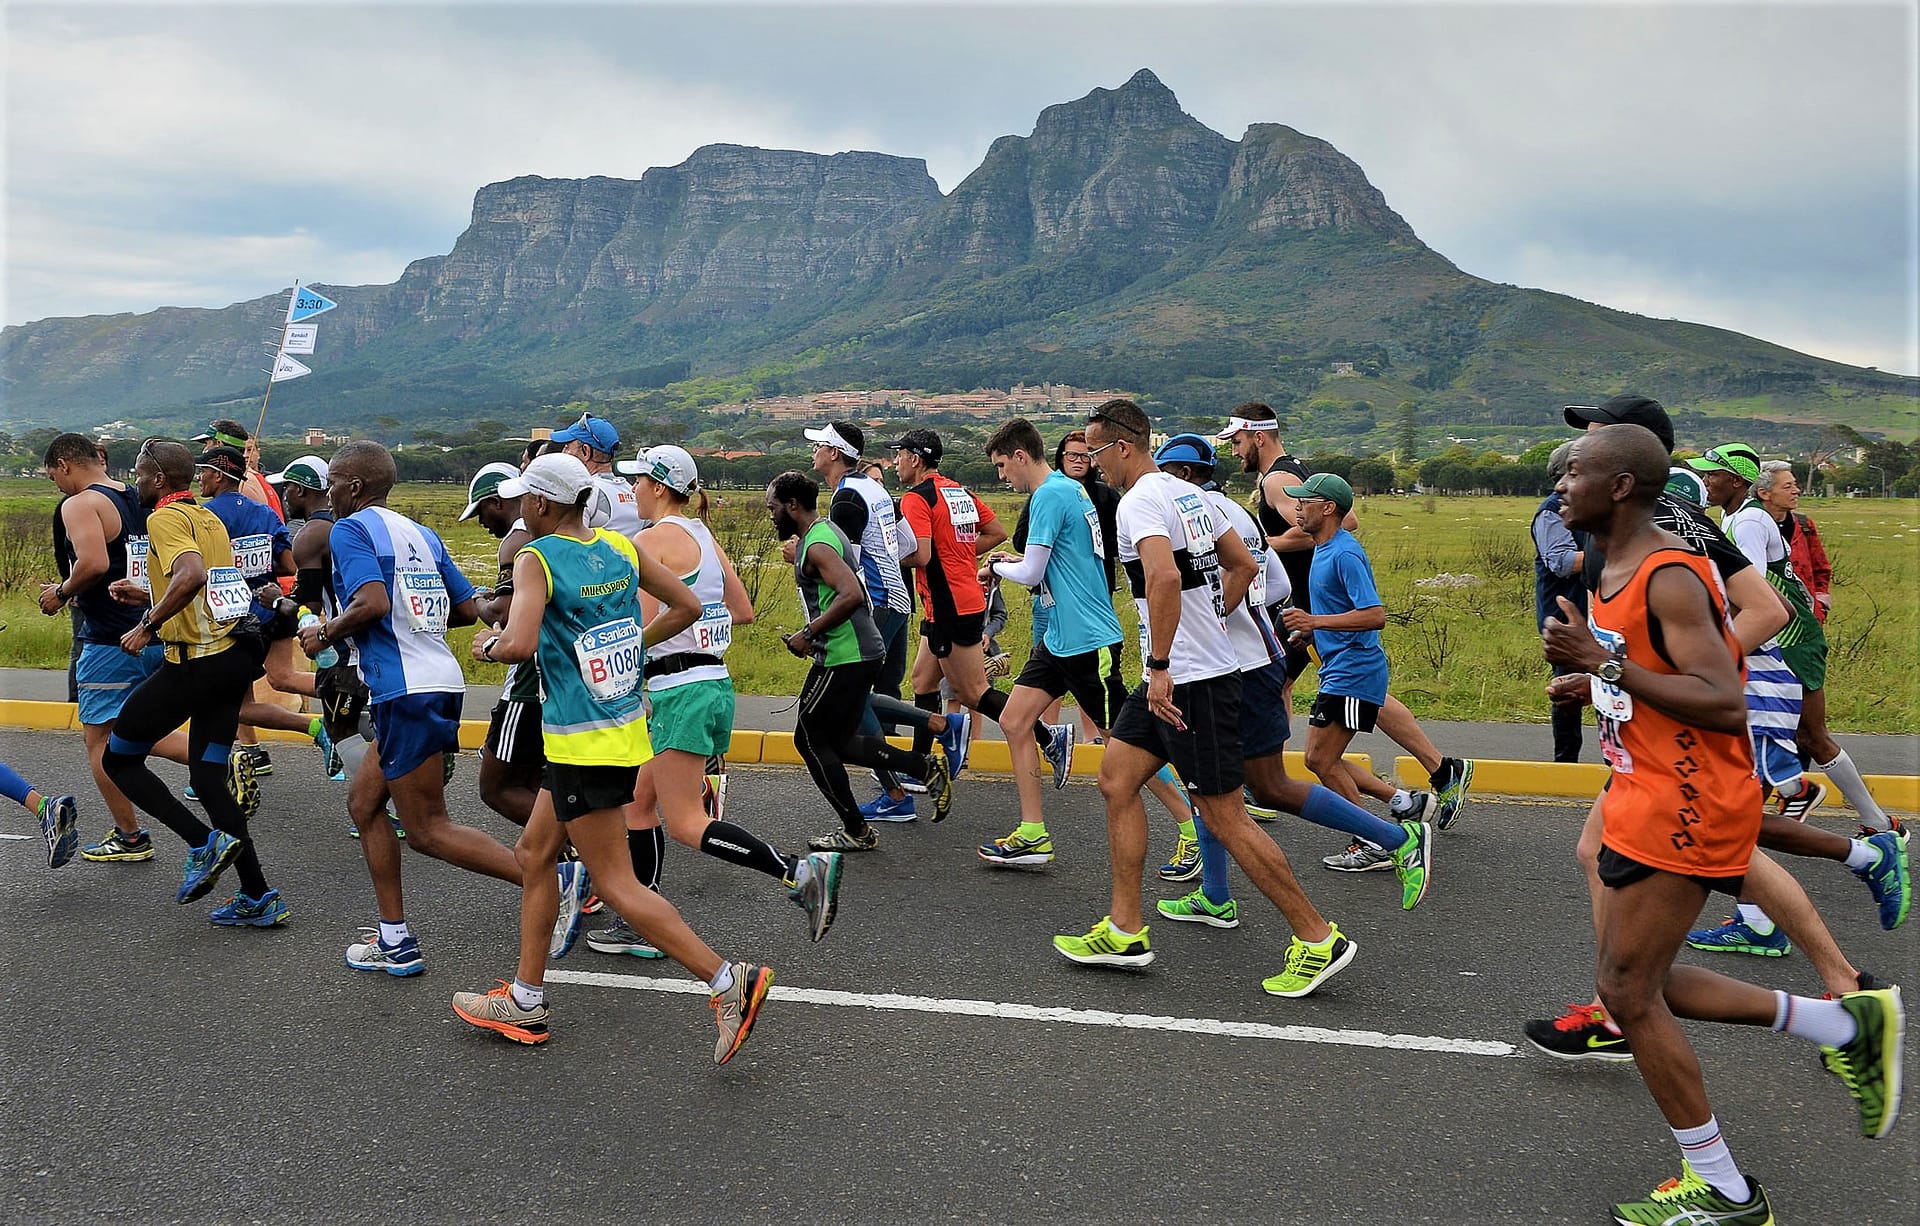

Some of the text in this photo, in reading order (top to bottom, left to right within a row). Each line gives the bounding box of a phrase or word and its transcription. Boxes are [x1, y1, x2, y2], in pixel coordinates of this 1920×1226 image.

[296, 298, 323, 310] 3:30
[234, 550, 271, 569] B1017
[215, 571, 241, 581] Sanlam
[581, 574, 632, 597] MULTISPORT
[210, 586, 252, 607] B1213
[598, 624, 637, 644] Sanlam
[588, 645, 640, 684] B1080
